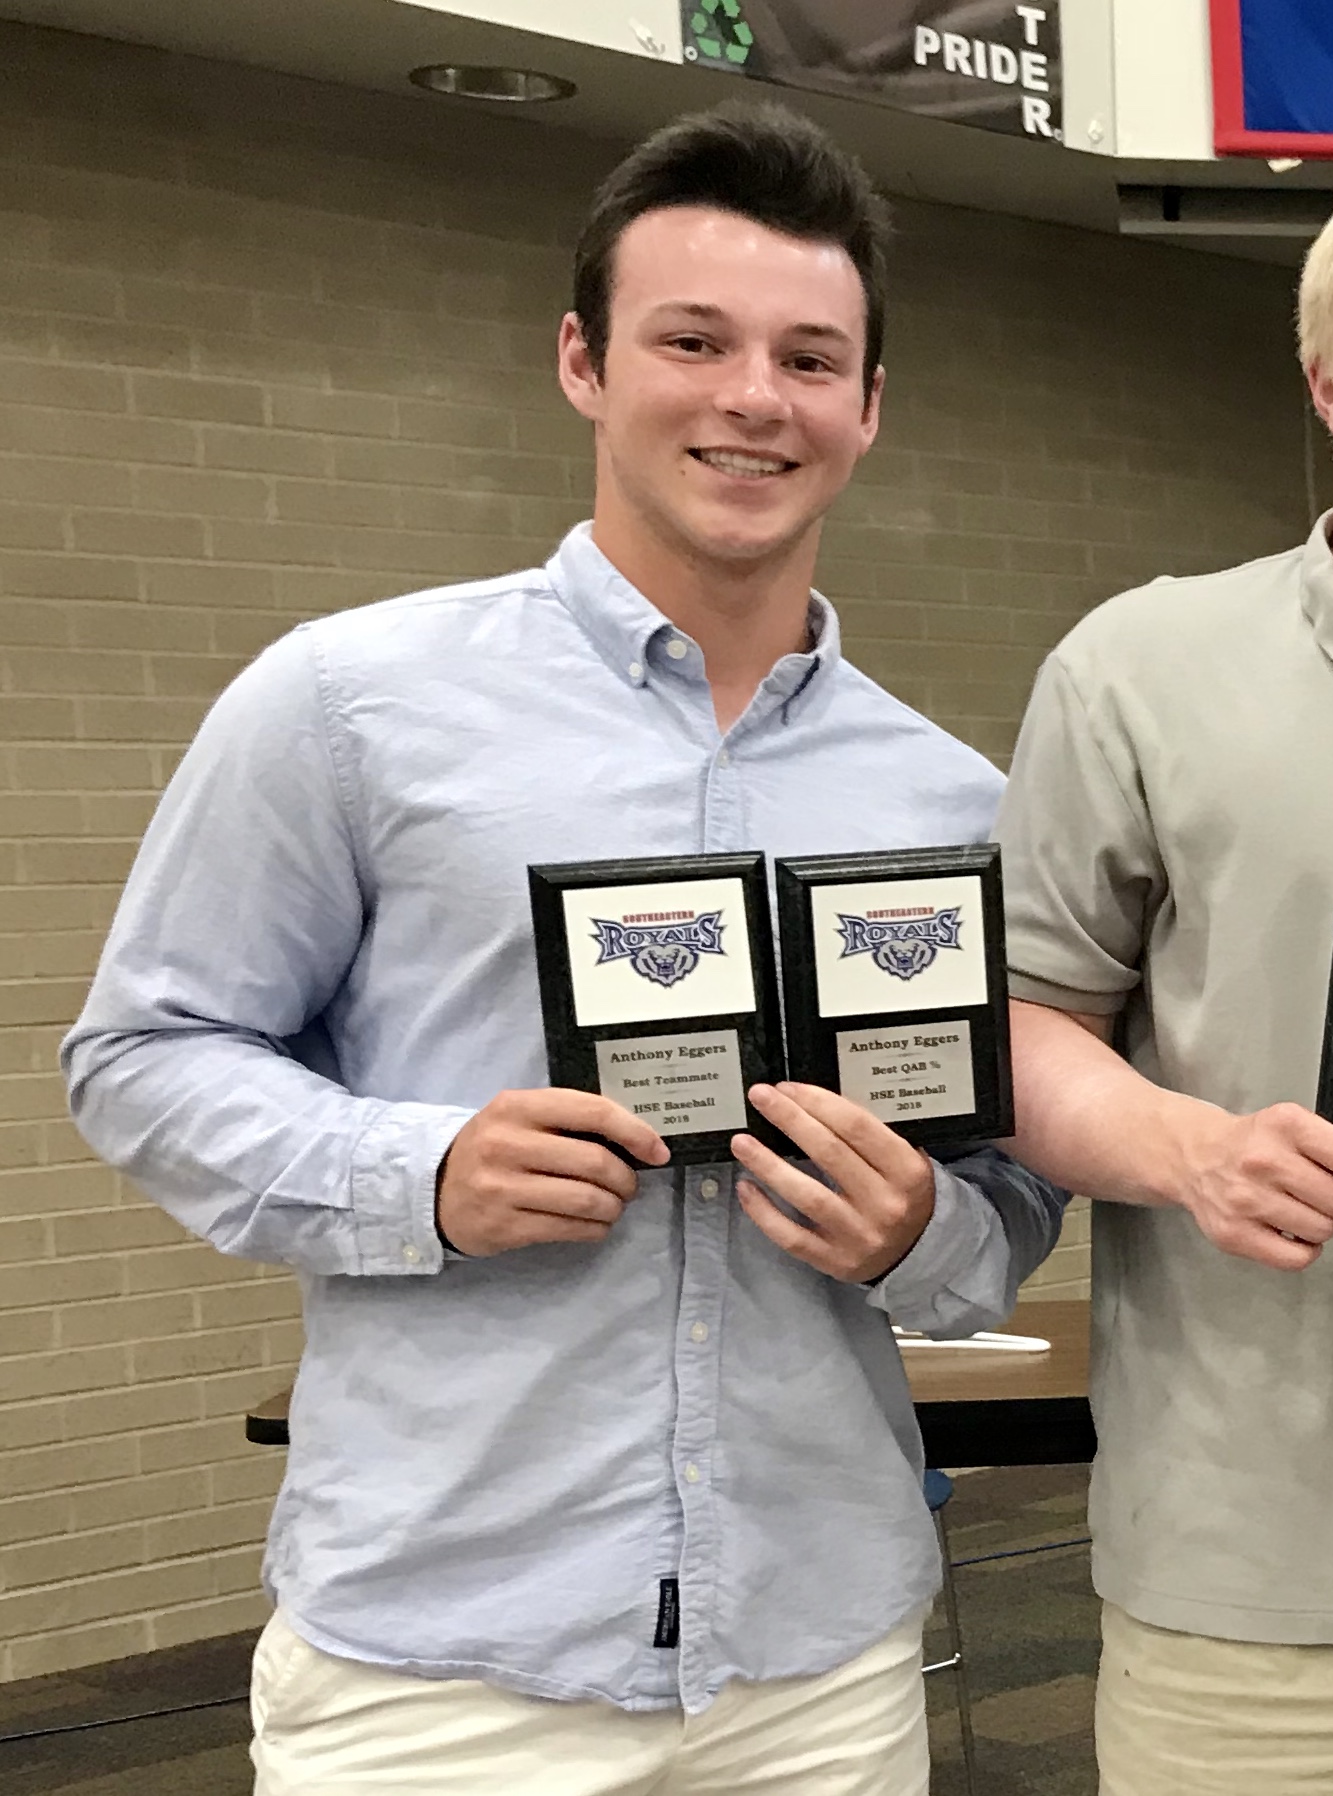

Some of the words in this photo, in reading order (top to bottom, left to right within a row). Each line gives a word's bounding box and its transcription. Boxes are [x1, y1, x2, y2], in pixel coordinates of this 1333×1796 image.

[914, 24, 1050, 92] PRIDE
[1014, 0, 1054, 137] TER
[601, 915, 720, 958] ROYALS
[847, 911, 955, 951] ROYALS
[849, 1039, 909, 1052] Anthony
[913, 1034, 960, 1047] Eggers
[610, 1049, 673, 1063] Anthony
[678, 1045, 727, 1059] Eggers
[871, 1066, 897, 1075] Best
[623, 1078, 650, 1088] Best
[654, 1072, 719, 1086] Teammate
[870, 1090, 895, 1101] HSE
[899, 1084, 947, 1098] Baseball
[633, 1102, 661, 1114] HSE
[664, 1097, 716, 1111] Baseball
[896, 1101, 922, 1111] 2018
[663, 1115, 690, 1125] 2018
